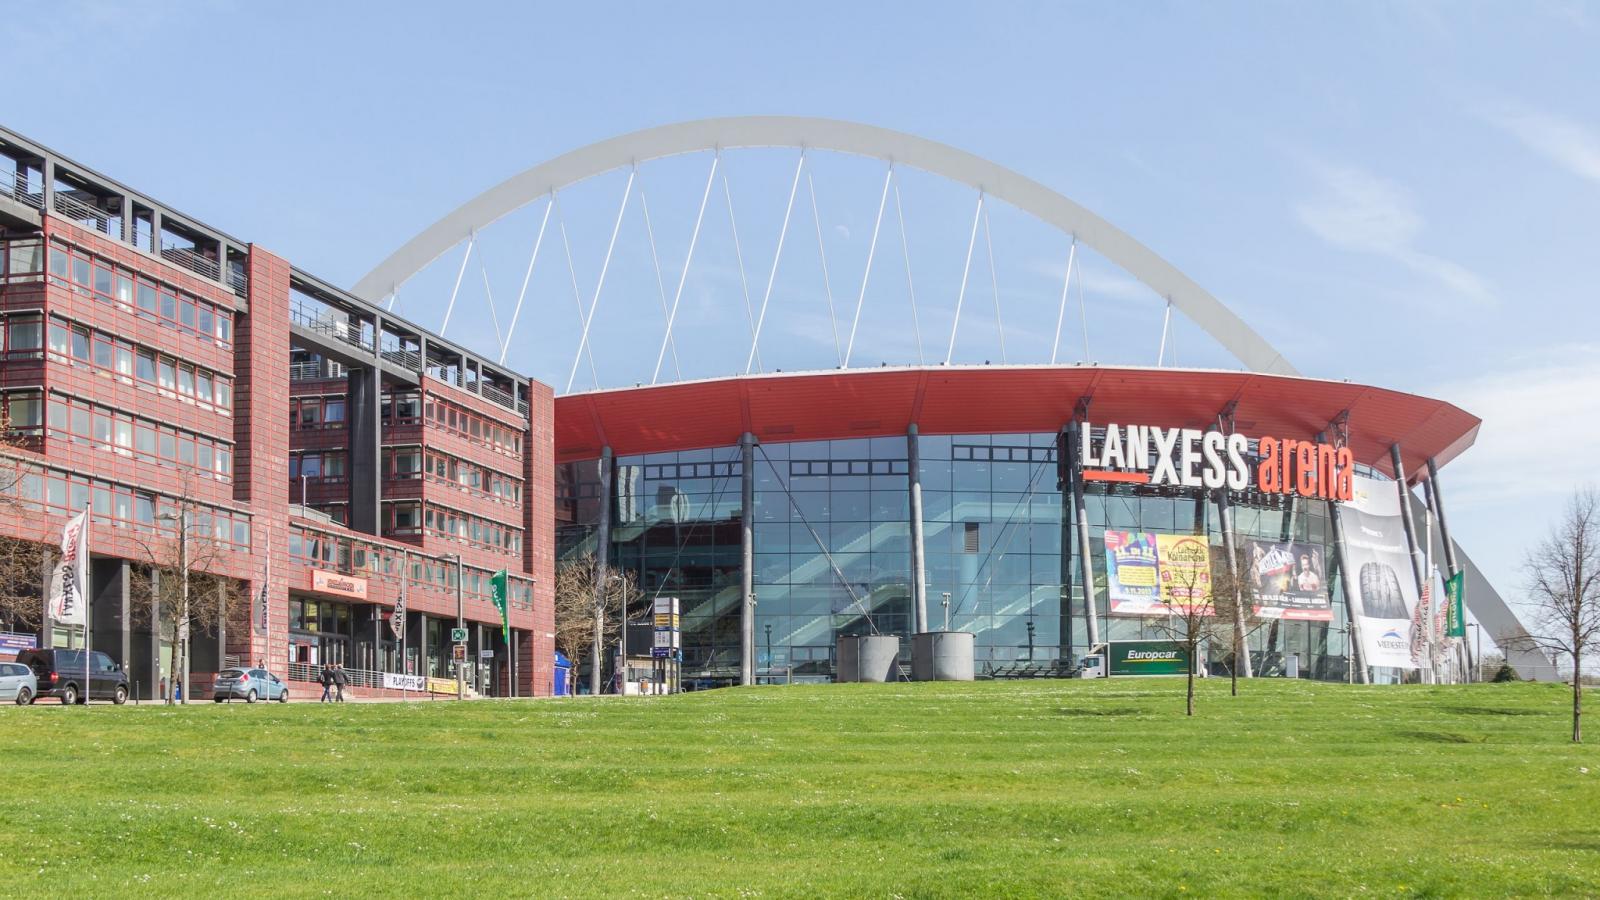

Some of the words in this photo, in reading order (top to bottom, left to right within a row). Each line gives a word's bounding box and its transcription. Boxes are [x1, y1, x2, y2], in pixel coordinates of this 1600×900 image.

[1081, 421, 1249, 490] LANXESS
[1258, 435, 1354, 501] arena
[1127, 649, 1178, 661] Europcar
